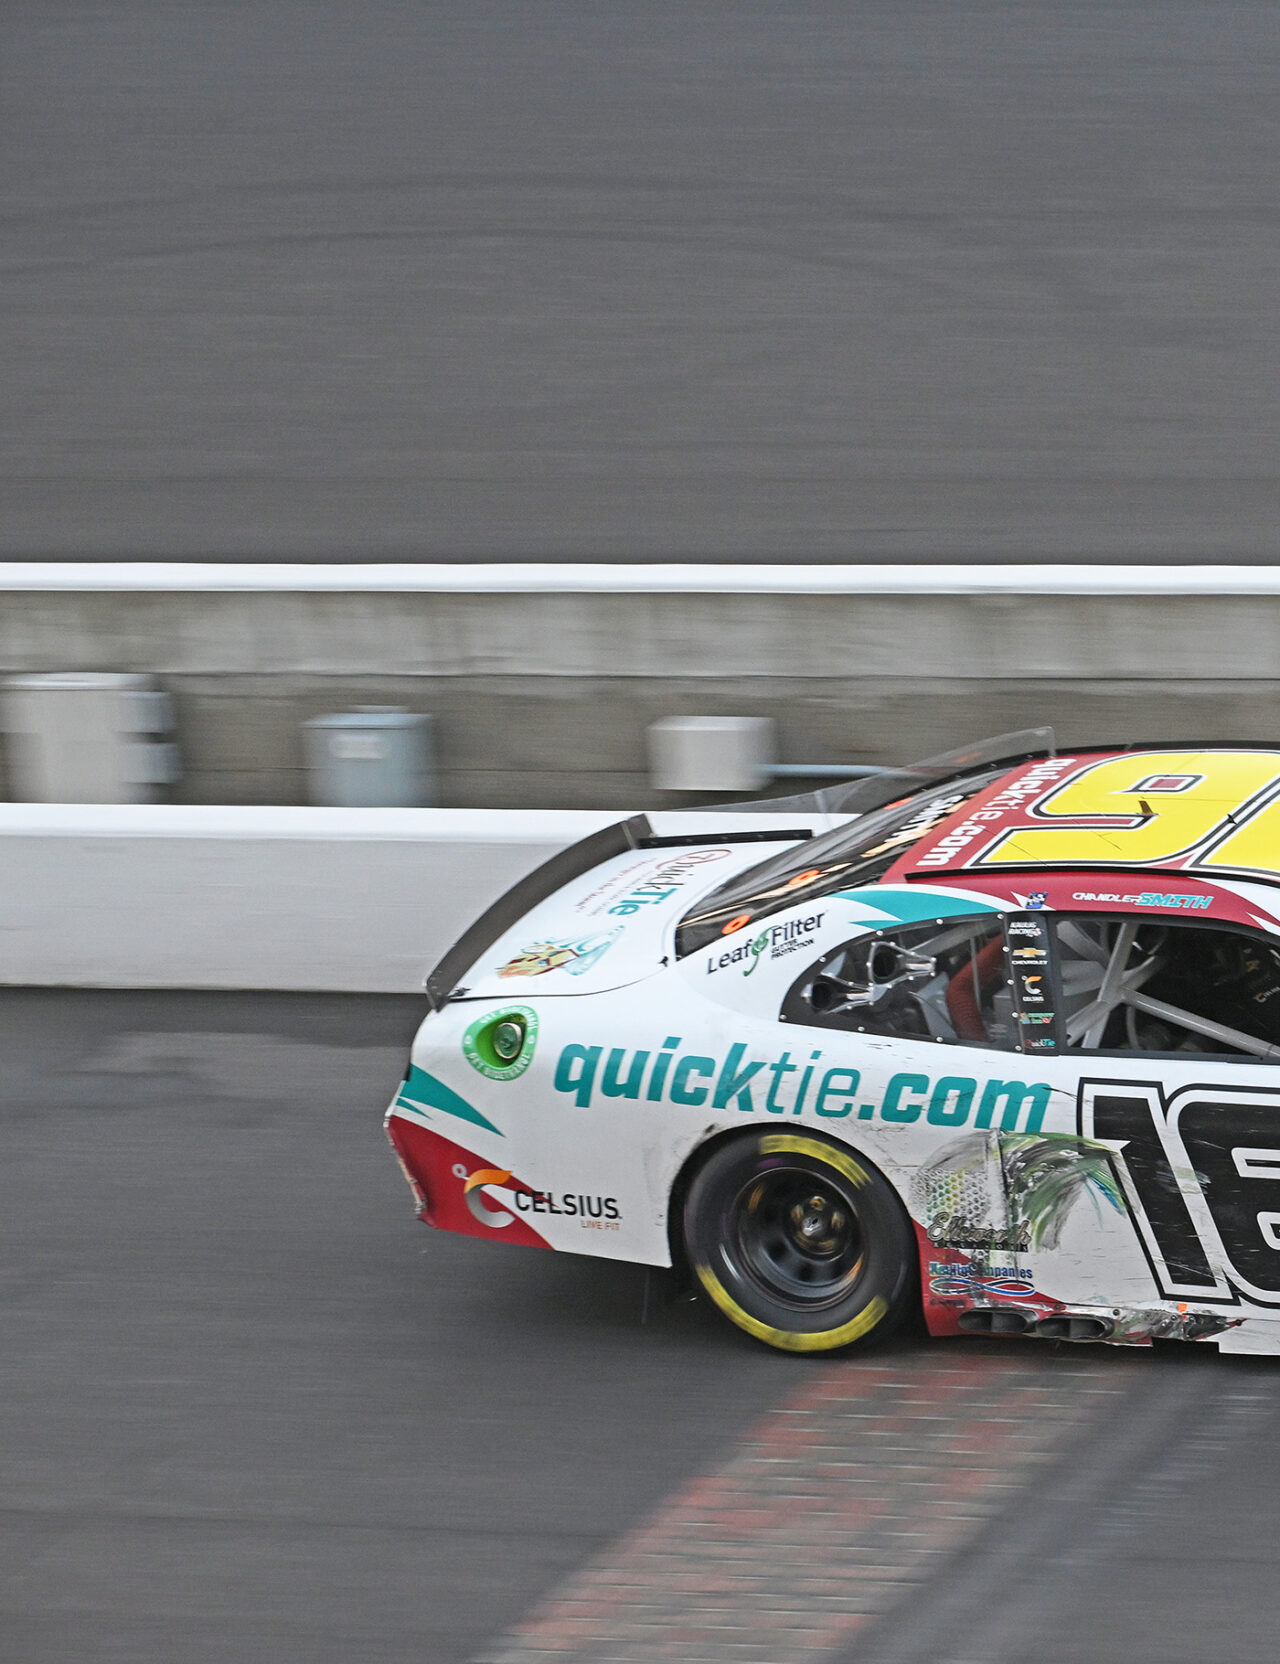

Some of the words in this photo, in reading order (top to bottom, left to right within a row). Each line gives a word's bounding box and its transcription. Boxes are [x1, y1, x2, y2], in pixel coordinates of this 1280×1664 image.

[916, 758, 1077, 866] quicktie.com
[1135, 892, 1215, 909] SMITH
[553, 1036, 1052, 1134] quicktie.com
[515, 1190, 620, 1219] CELSIUS
